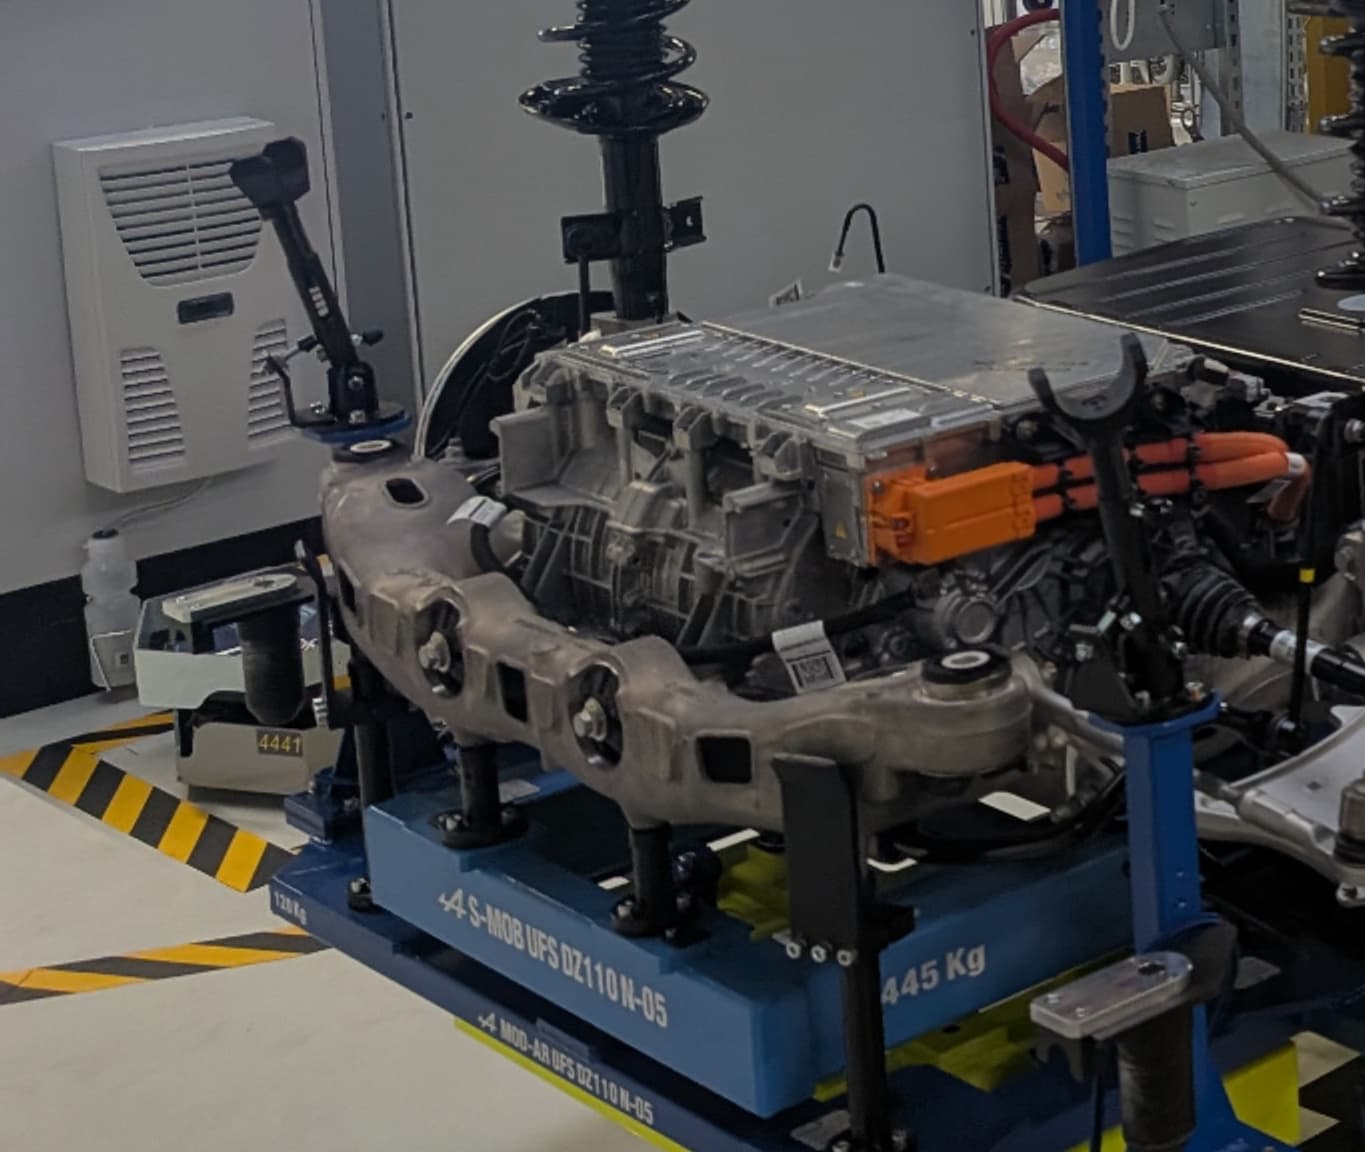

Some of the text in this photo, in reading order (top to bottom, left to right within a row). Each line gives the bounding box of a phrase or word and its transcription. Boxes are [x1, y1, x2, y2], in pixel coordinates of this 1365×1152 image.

[258, 733, 301, 754] 4441
[467, 893, 525, 951] S-MOB
[525, 923, 560, 969] UFS
[561, 941, 619, 1003] DZ110
[620, 974, 668, 1028] N-05
[880, 944, 986, 1005] 445 Kg
